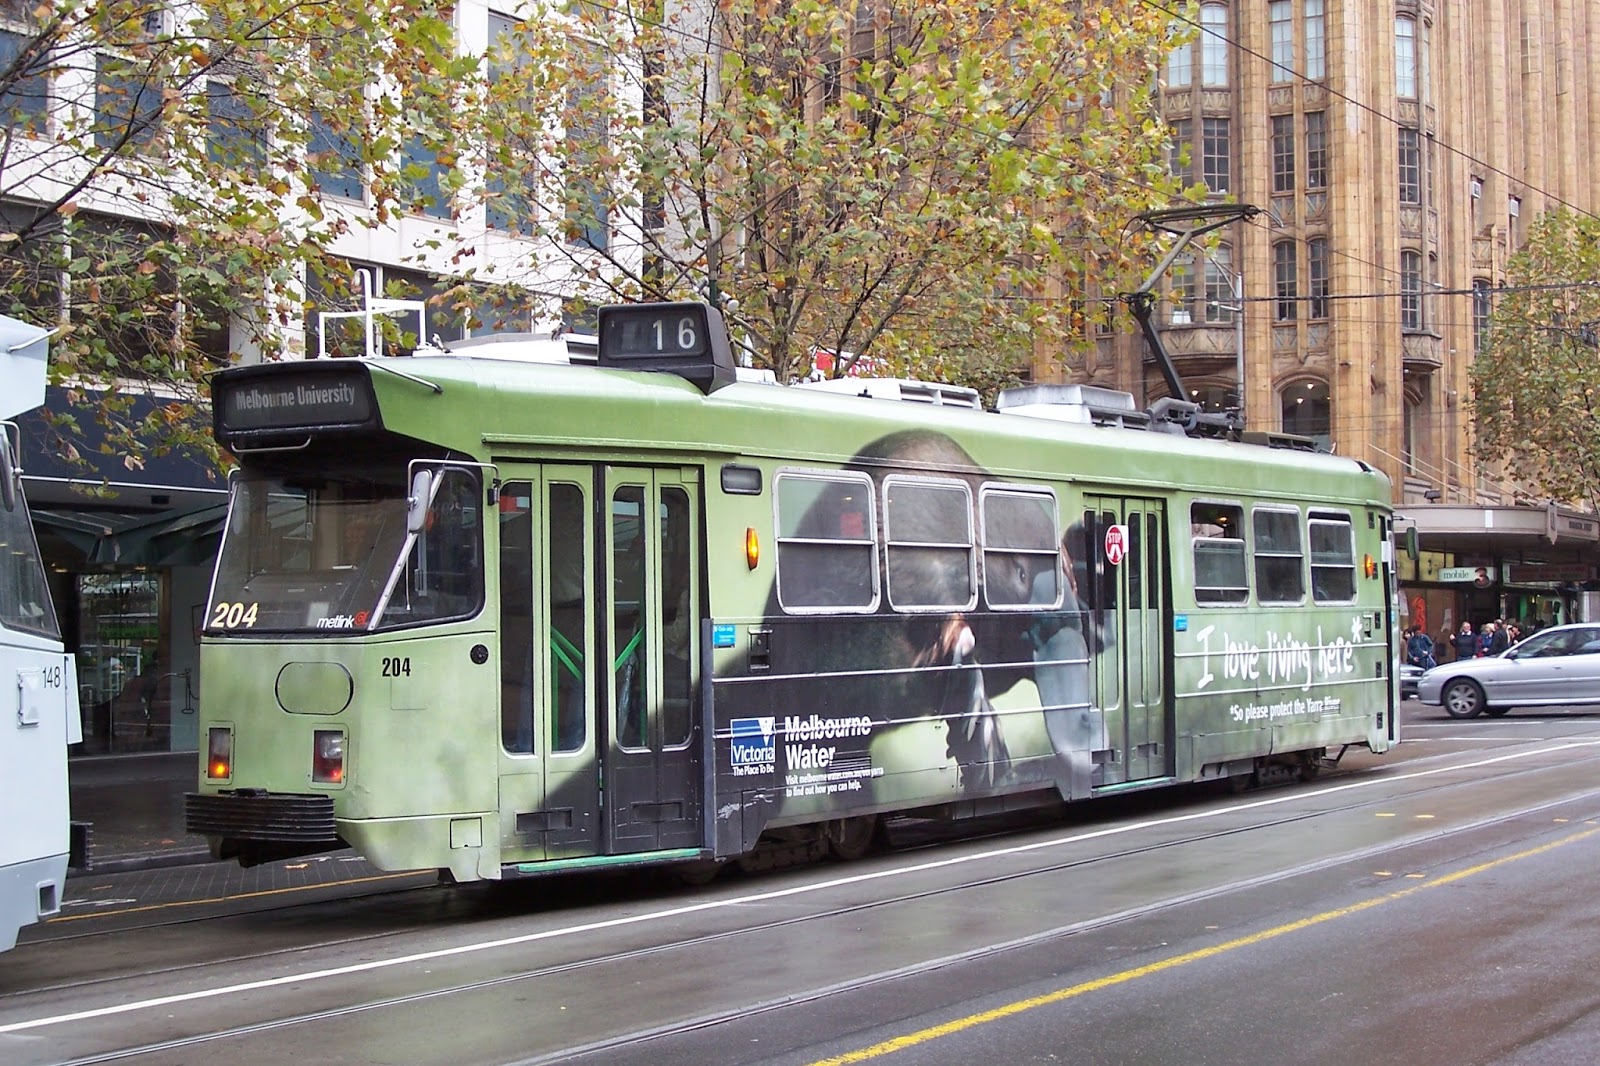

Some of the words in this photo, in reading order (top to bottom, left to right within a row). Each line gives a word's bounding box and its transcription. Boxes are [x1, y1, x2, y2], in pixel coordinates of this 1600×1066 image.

[652, 317, 696, 350] 16
[235, 390, 295, 410] Melbourne
[296, 383, 355, 405] University
[1108, 532, 1121, 544] STOP
[1443, 569, 1469, 579] mobile
[210, 602, 258, 628] 204
[316, 615, 354, 628] metlink
[382, 657, 411, 677] 204
[1196, 624, 1216, 689] I
[1223, 631, 1260, 681] love
[1266, 630, 1313, 692] living
[42, 666, 61, 689] 148
[1245, 703, 1269, 724] please
[1270, 700, 1294, 721] protect
[1294, 698, 1306, 714] the
[1306, 698, 1323, 713] Yarra
[784, 714, 872, 742] Melbourne
[732, 744, 775, 763] Victoria
[785, 744, 836, 770] Water
[732, 766, 744, 777] The
[744, 764, 760, 776] Place
[759, 763, 767, 774] To
[766, 763, 775, 774] Be
[785, 773, 799, 786] Visit
[785, 788, 793, 798] to
[793, 785, 804, 796] find
[805, 785, 815, 795] out
[814, 783, 827, 794] how
[827, 783, 838, 796] you
[838, 781, 848, 792] can
